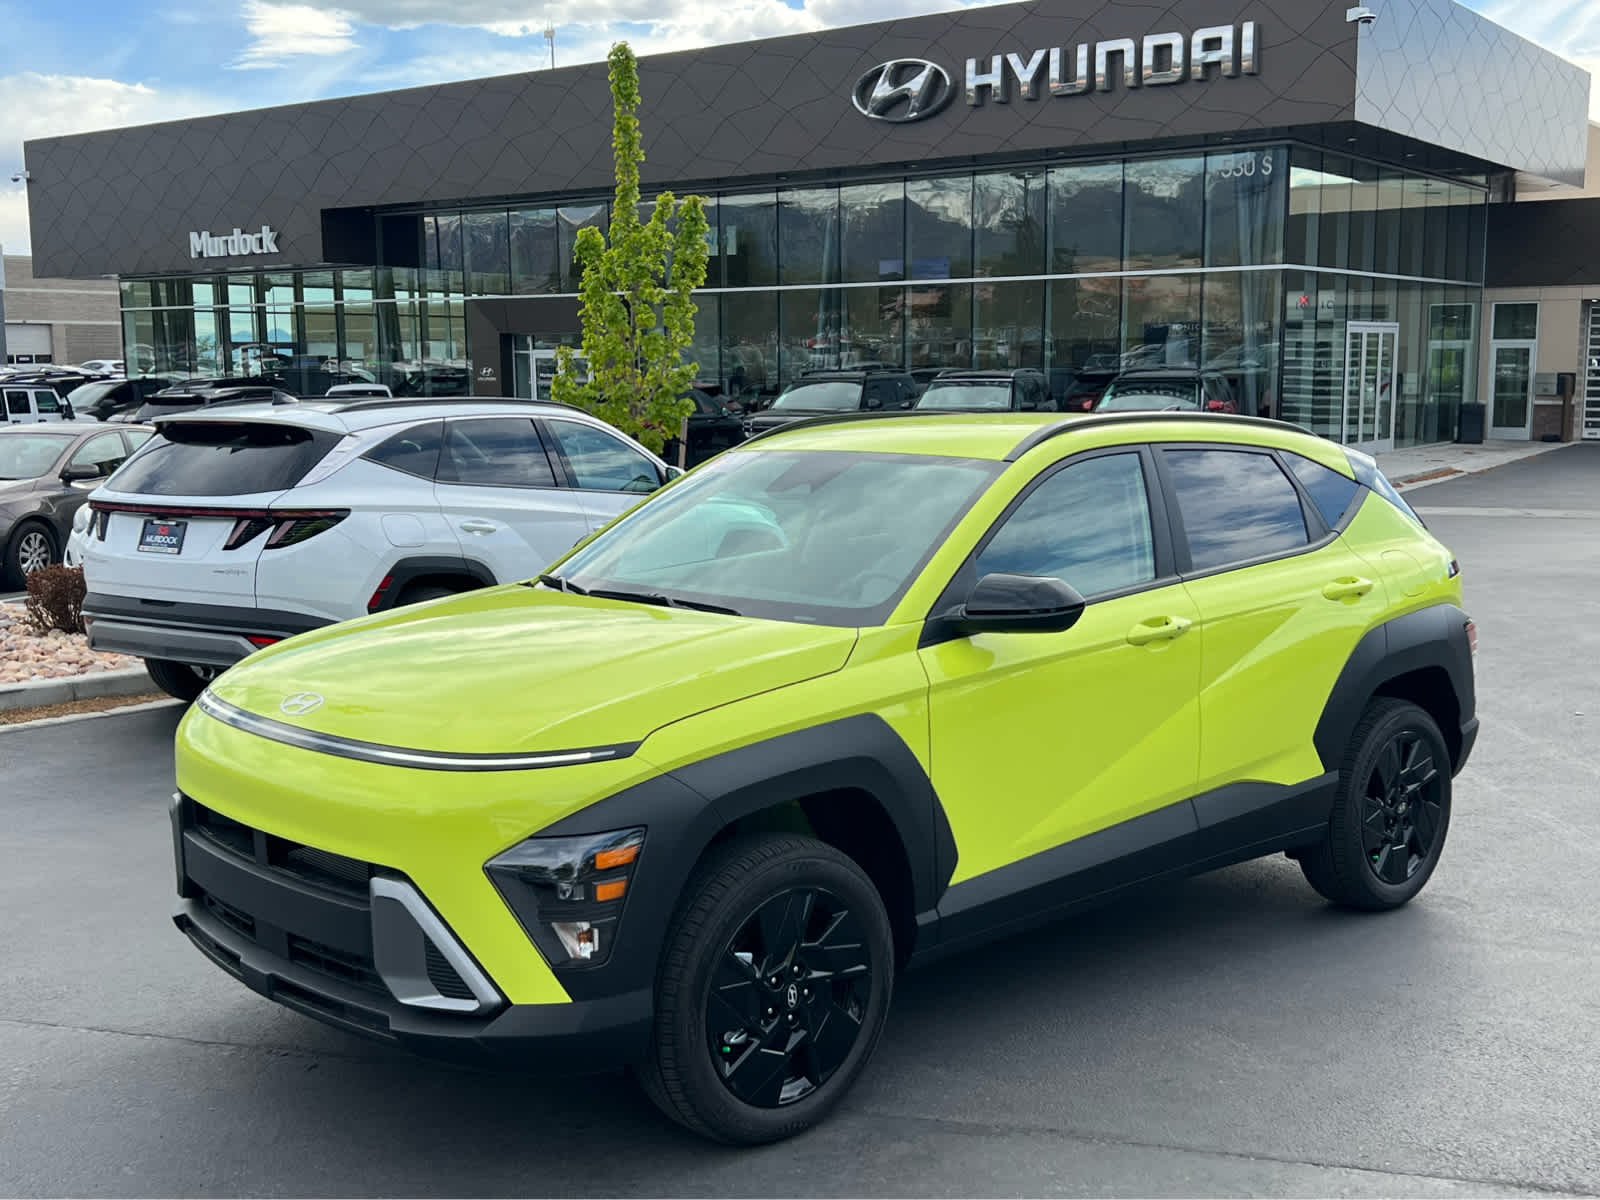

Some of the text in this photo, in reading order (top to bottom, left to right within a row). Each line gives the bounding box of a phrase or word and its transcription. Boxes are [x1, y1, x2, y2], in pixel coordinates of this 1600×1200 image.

[965, 21, 1257, 106] HYUNDAI
[1261, 155, 1273, 175] S
[189, 225, 280, 258] Murdock
